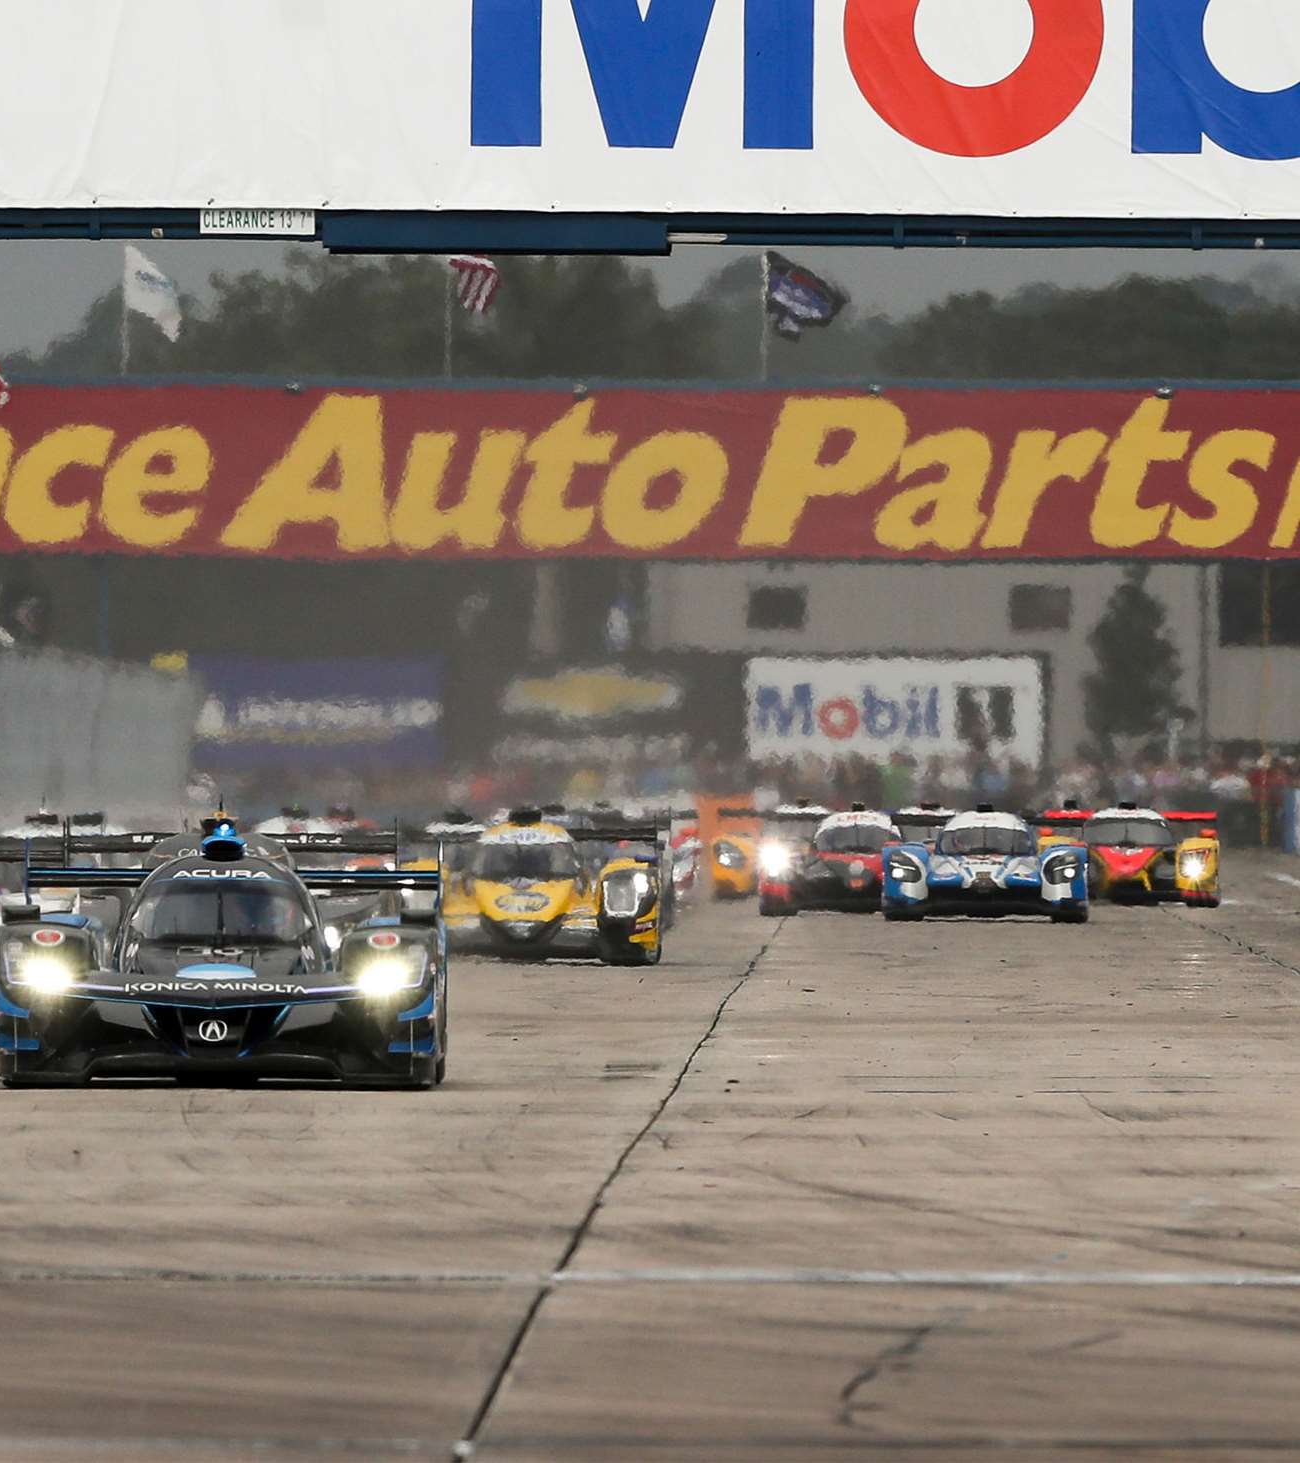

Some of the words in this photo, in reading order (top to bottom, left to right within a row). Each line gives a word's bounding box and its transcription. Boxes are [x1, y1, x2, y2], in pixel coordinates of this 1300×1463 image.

[203, 210, 275, 229] CLEARANCE
[219, 394, 728, 552] Auto
[739, 396, 1277, 552] Parts
[754, 682, 941, 739] Mobil
[173, 868, 272, 879] ACURA
[124, 982, 207, 996] KONICA
[214, 982, 309, 995] MINOLTA
